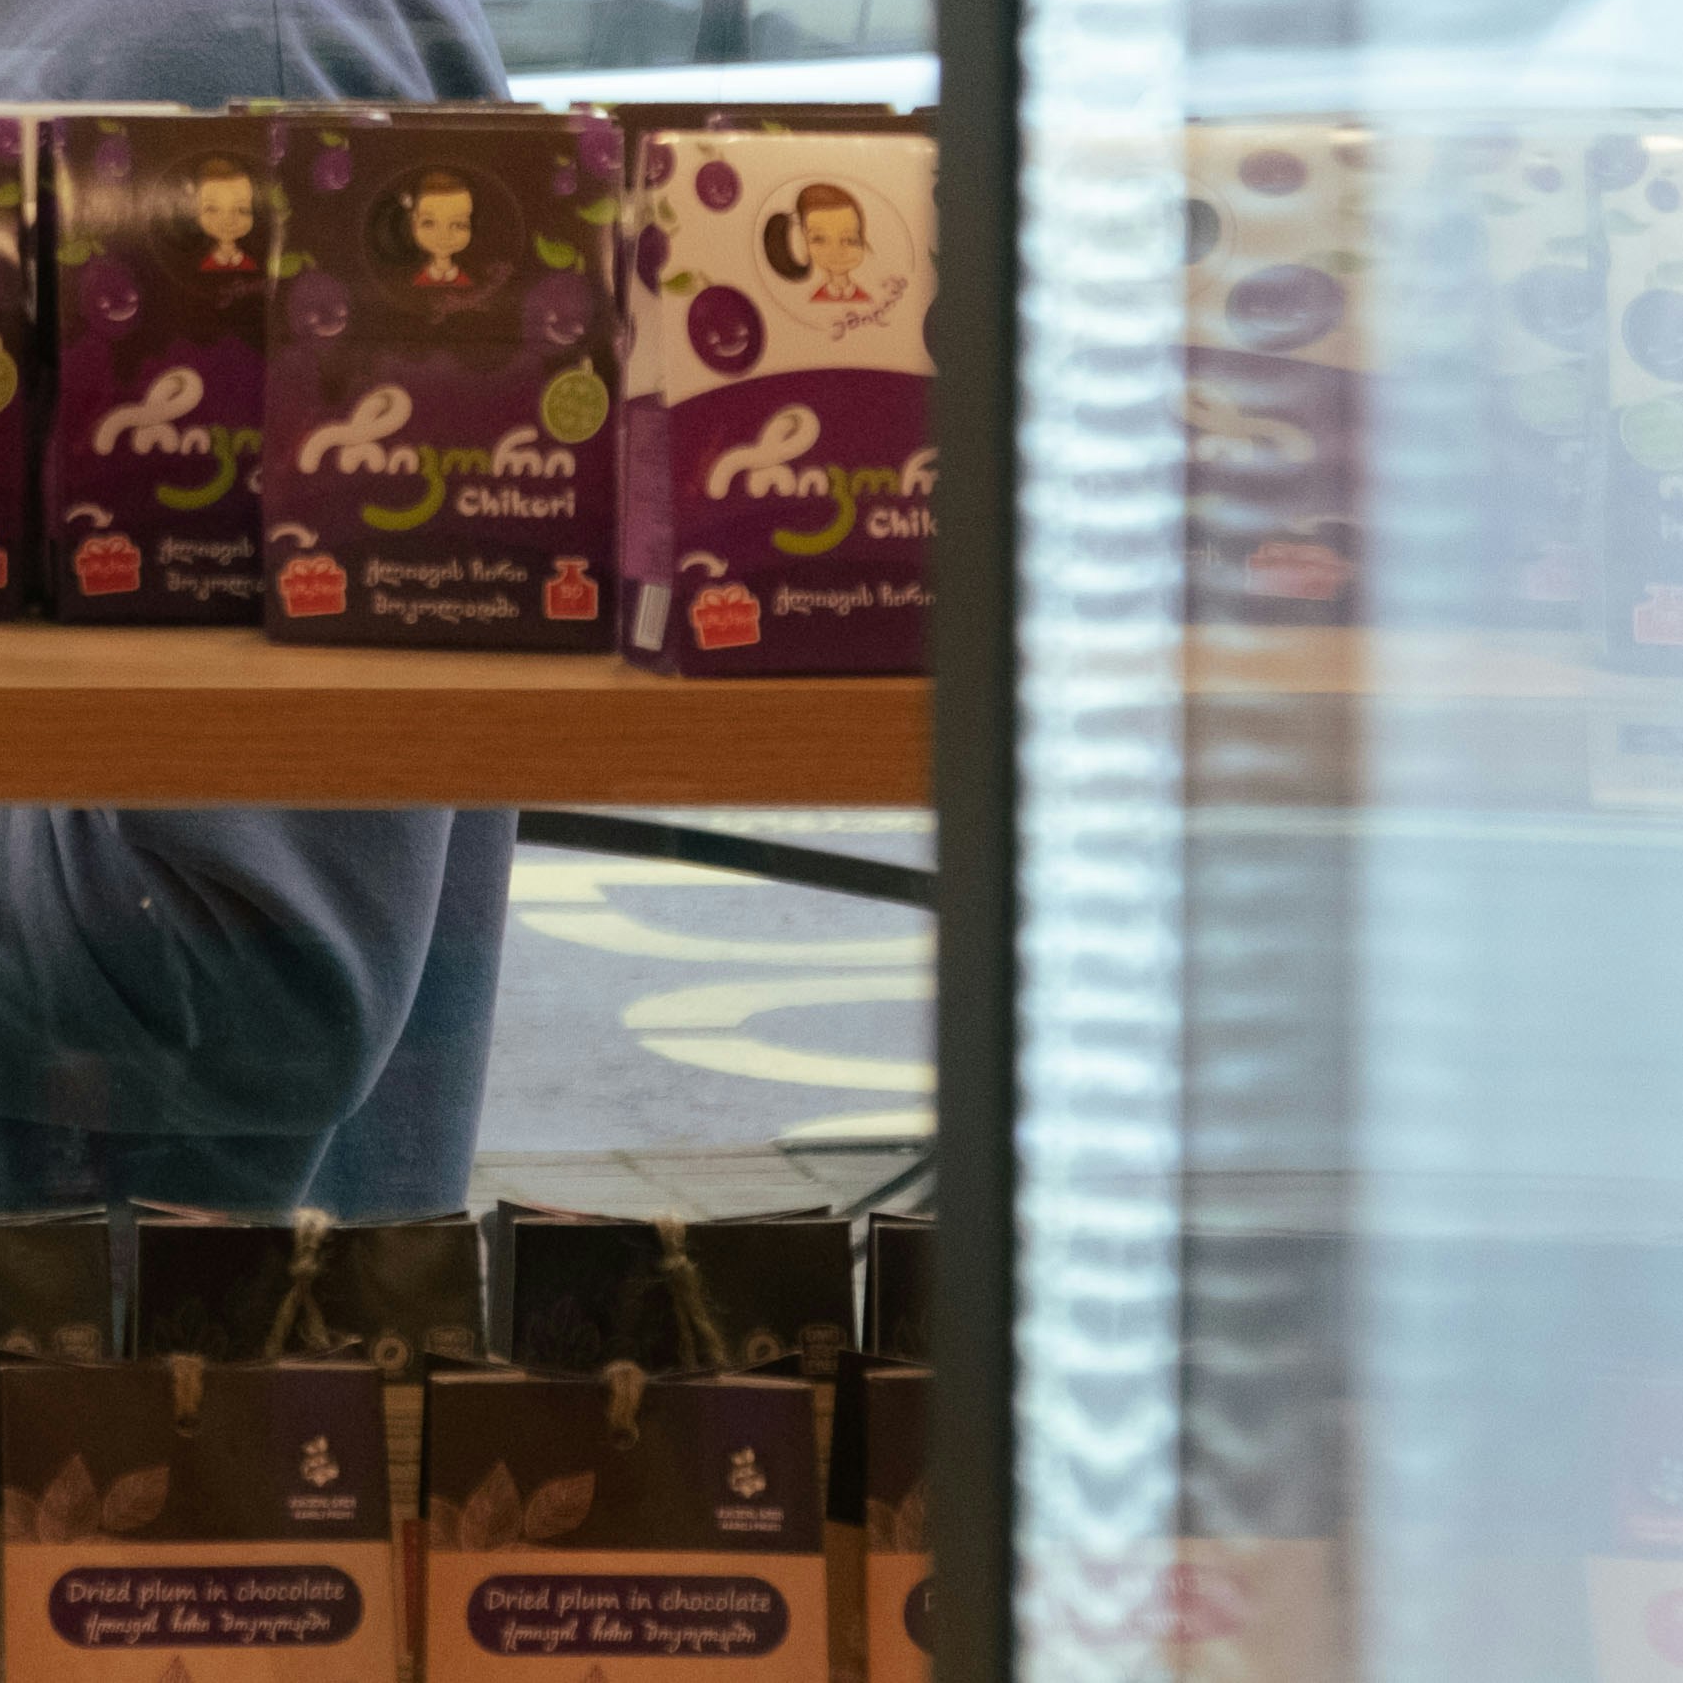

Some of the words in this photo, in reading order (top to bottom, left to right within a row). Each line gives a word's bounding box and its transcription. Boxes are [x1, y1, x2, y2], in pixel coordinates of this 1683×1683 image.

[455, 487, 577, 520] Chikori
[65, 1579, 131, 1603] Dried
[138, 1578, 199, 1611] plum
[205, 1579, 228, 1601] in
[236, 1576, 347, 1602] chocolate
[483, 1587, 550, 1612] Dried
[555, 1586, 621, 1621] plum
[629, 1587, 654, 1611] in
[661, 1584, 772, 1613] chocolate
